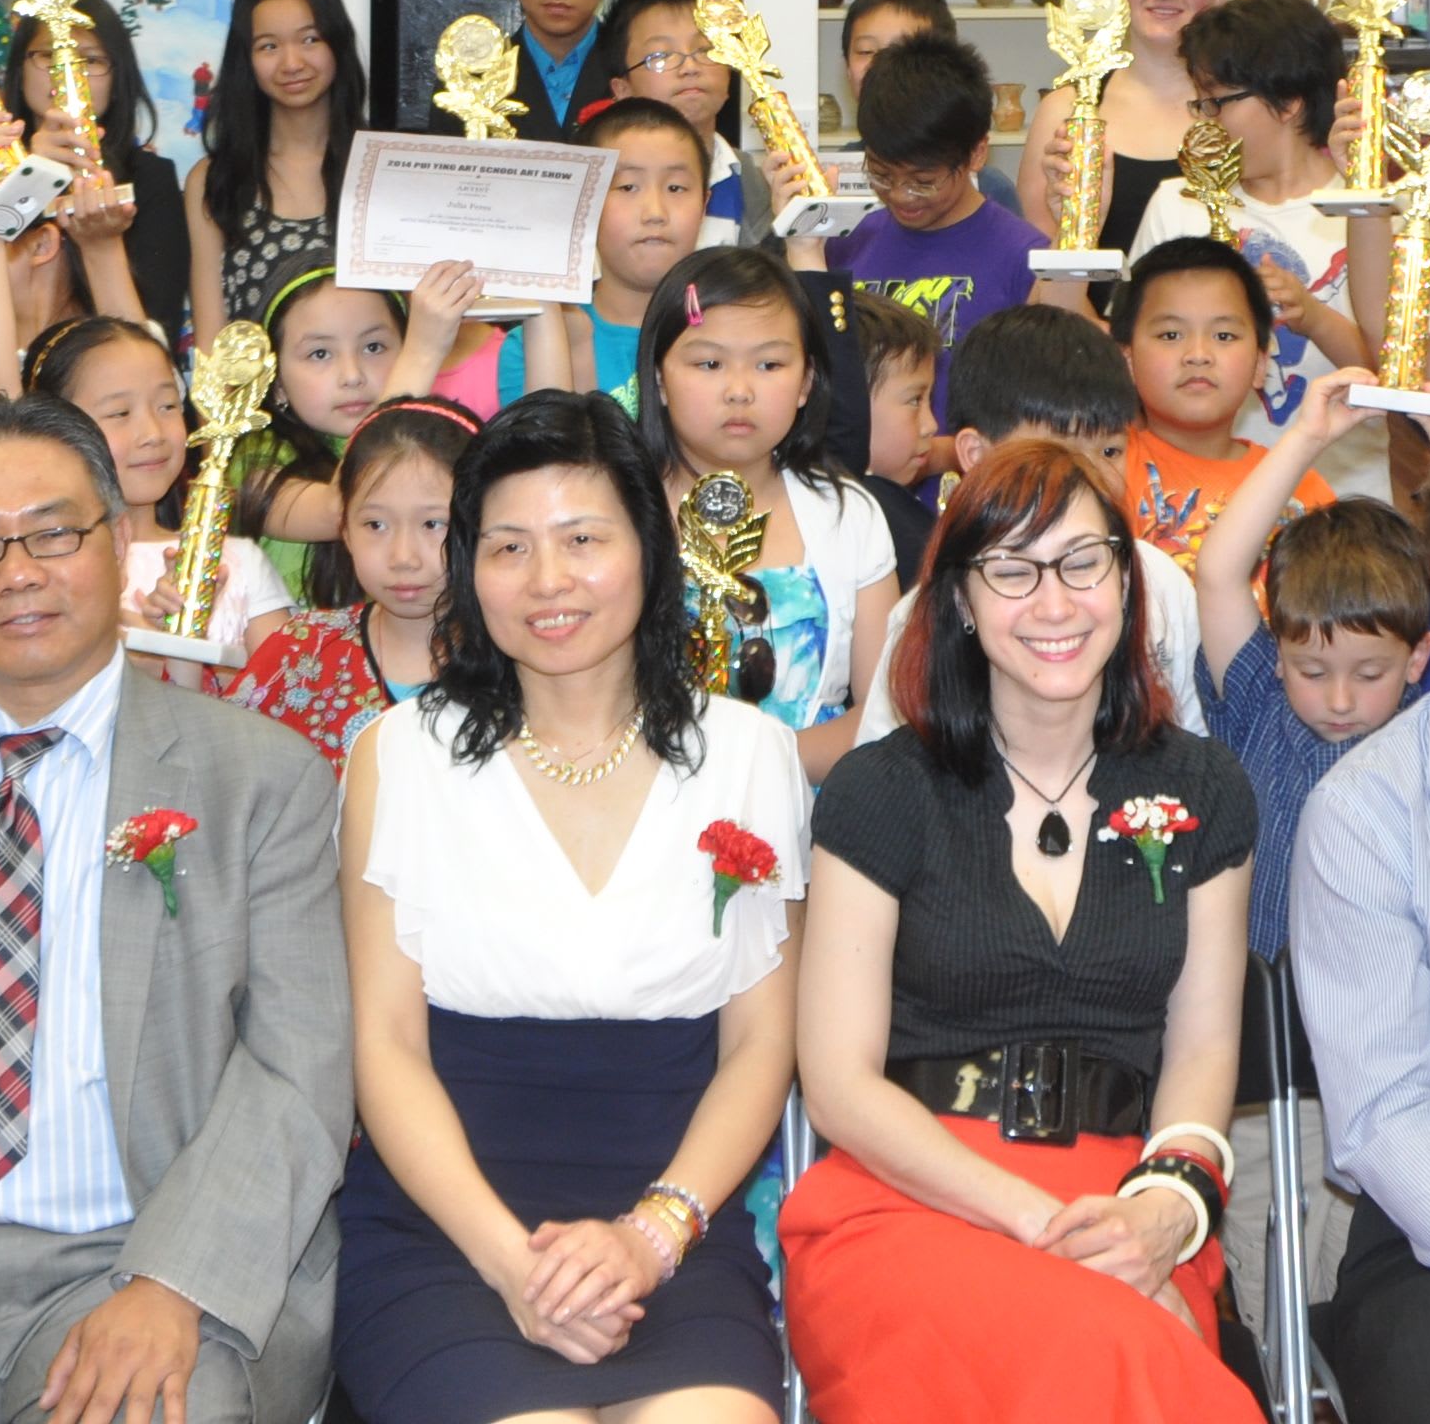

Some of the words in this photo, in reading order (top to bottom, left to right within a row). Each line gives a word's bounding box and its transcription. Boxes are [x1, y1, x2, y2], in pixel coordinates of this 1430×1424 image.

[387, 158, 412, 169] 2014
[413, 160, 431, 170] PUI
[432, 162, 456, 172] YING
[458, 164, 478, 173] ART
[480, 165, 518, 176] SCHOOL
[520, 168, 539, 177] ART
[541, 170, 573, 180] SHOW
